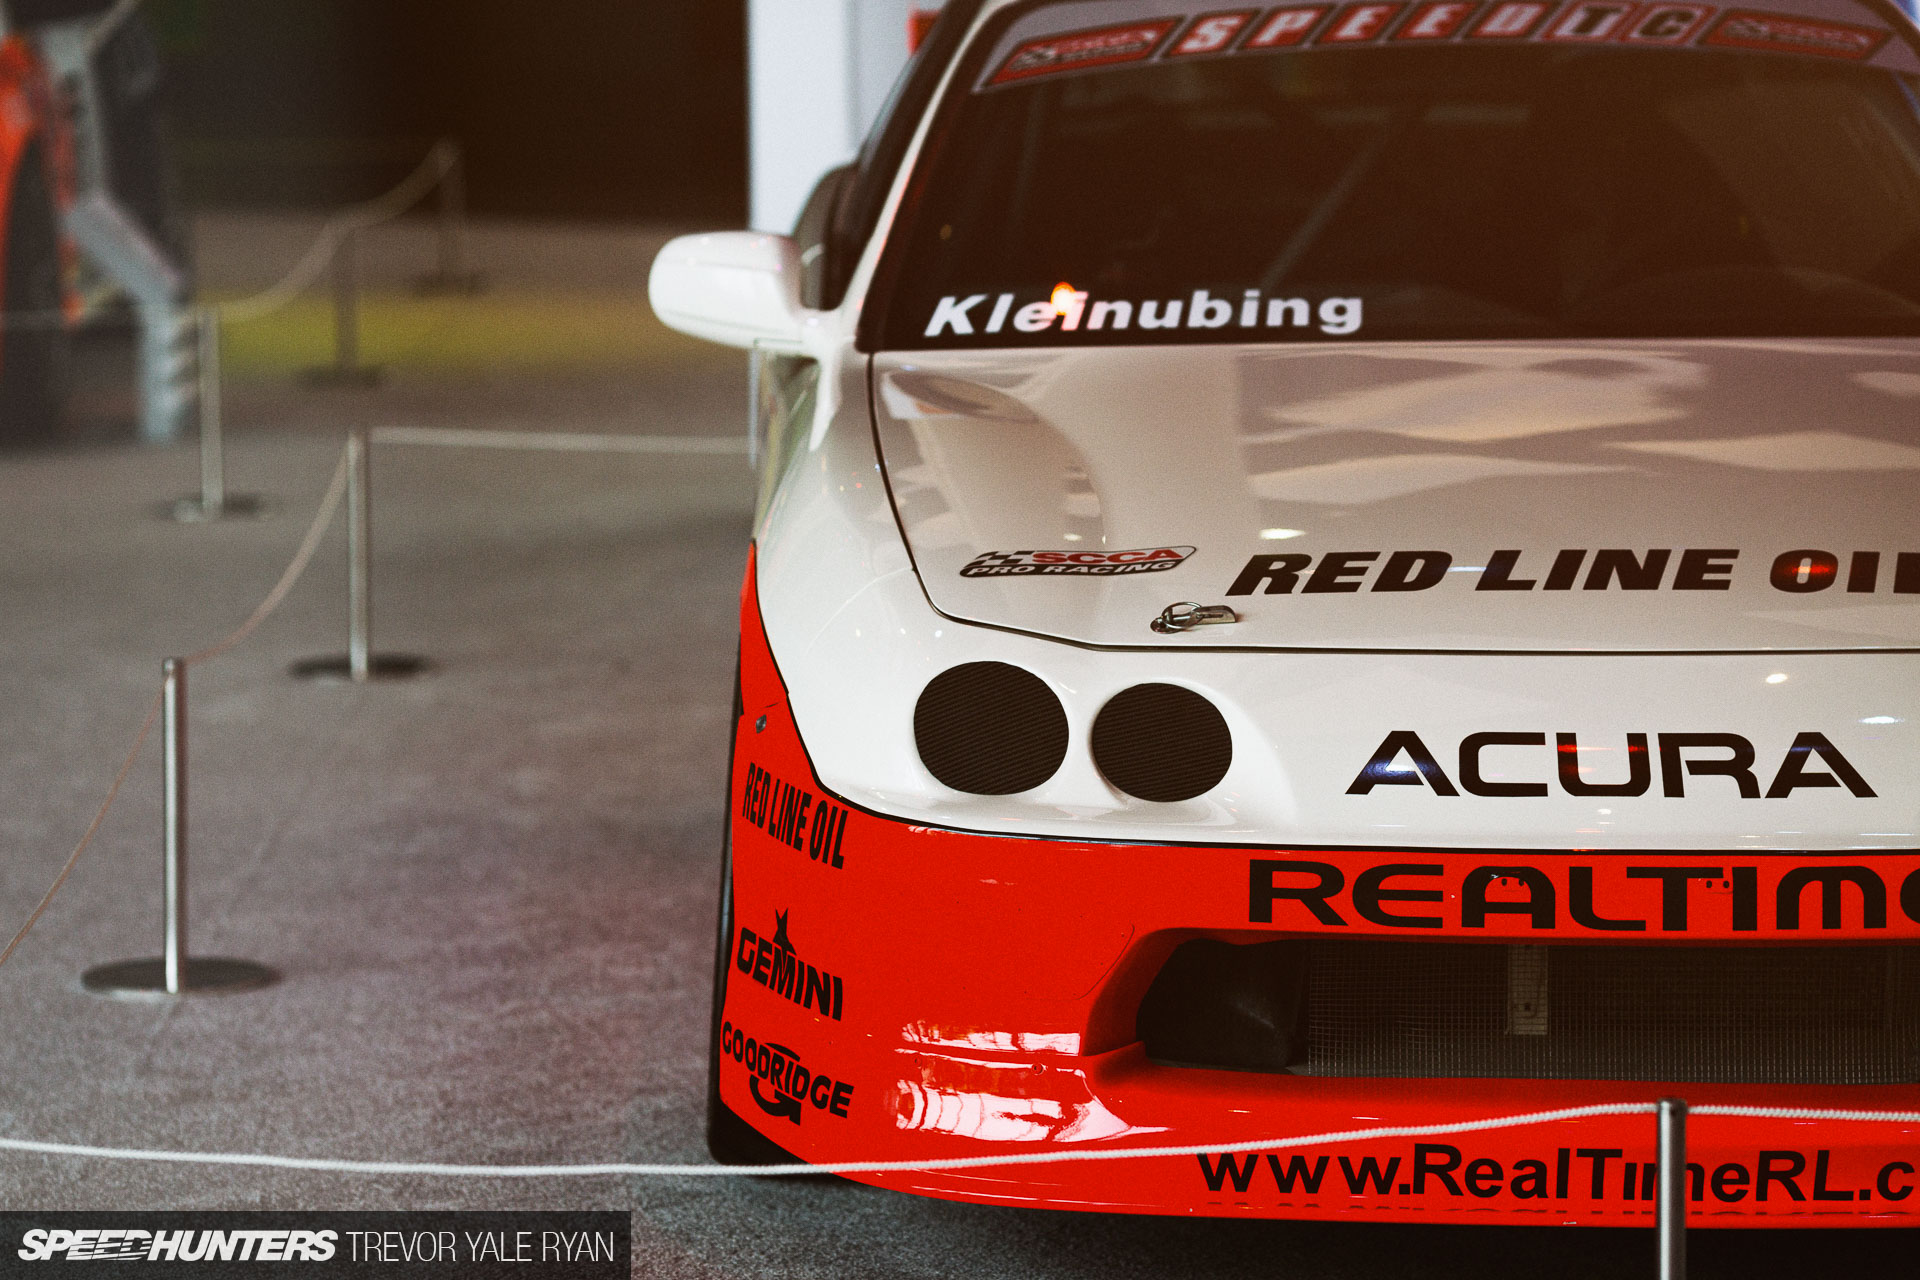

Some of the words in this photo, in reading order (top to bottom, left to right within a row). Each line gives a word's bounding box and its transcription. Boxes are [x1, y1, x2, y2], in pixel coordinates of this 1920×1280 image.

[924, 289, 1363, 336] Kleinubing
[966, 565, 1036, 576] PRO
[1043, 561, 1177, 574] RACING
[1032, 549, 1184, 564] SCCA
[1225, 550, 1453, 596] RED
[1474, 549, 1740, 591] LINE
[1345, 730, 1879, 799] ACURA
[742, 762, 771, 829] RED
[768, 778, 812, 852] LINE
[809, 800, 849, 870] OIL
[1249, 859, 1920, 931] REALTIM
[737, 927, 843, 1022] GEMINI
[722, 1021, 855, 1119] GOODRIDGE
